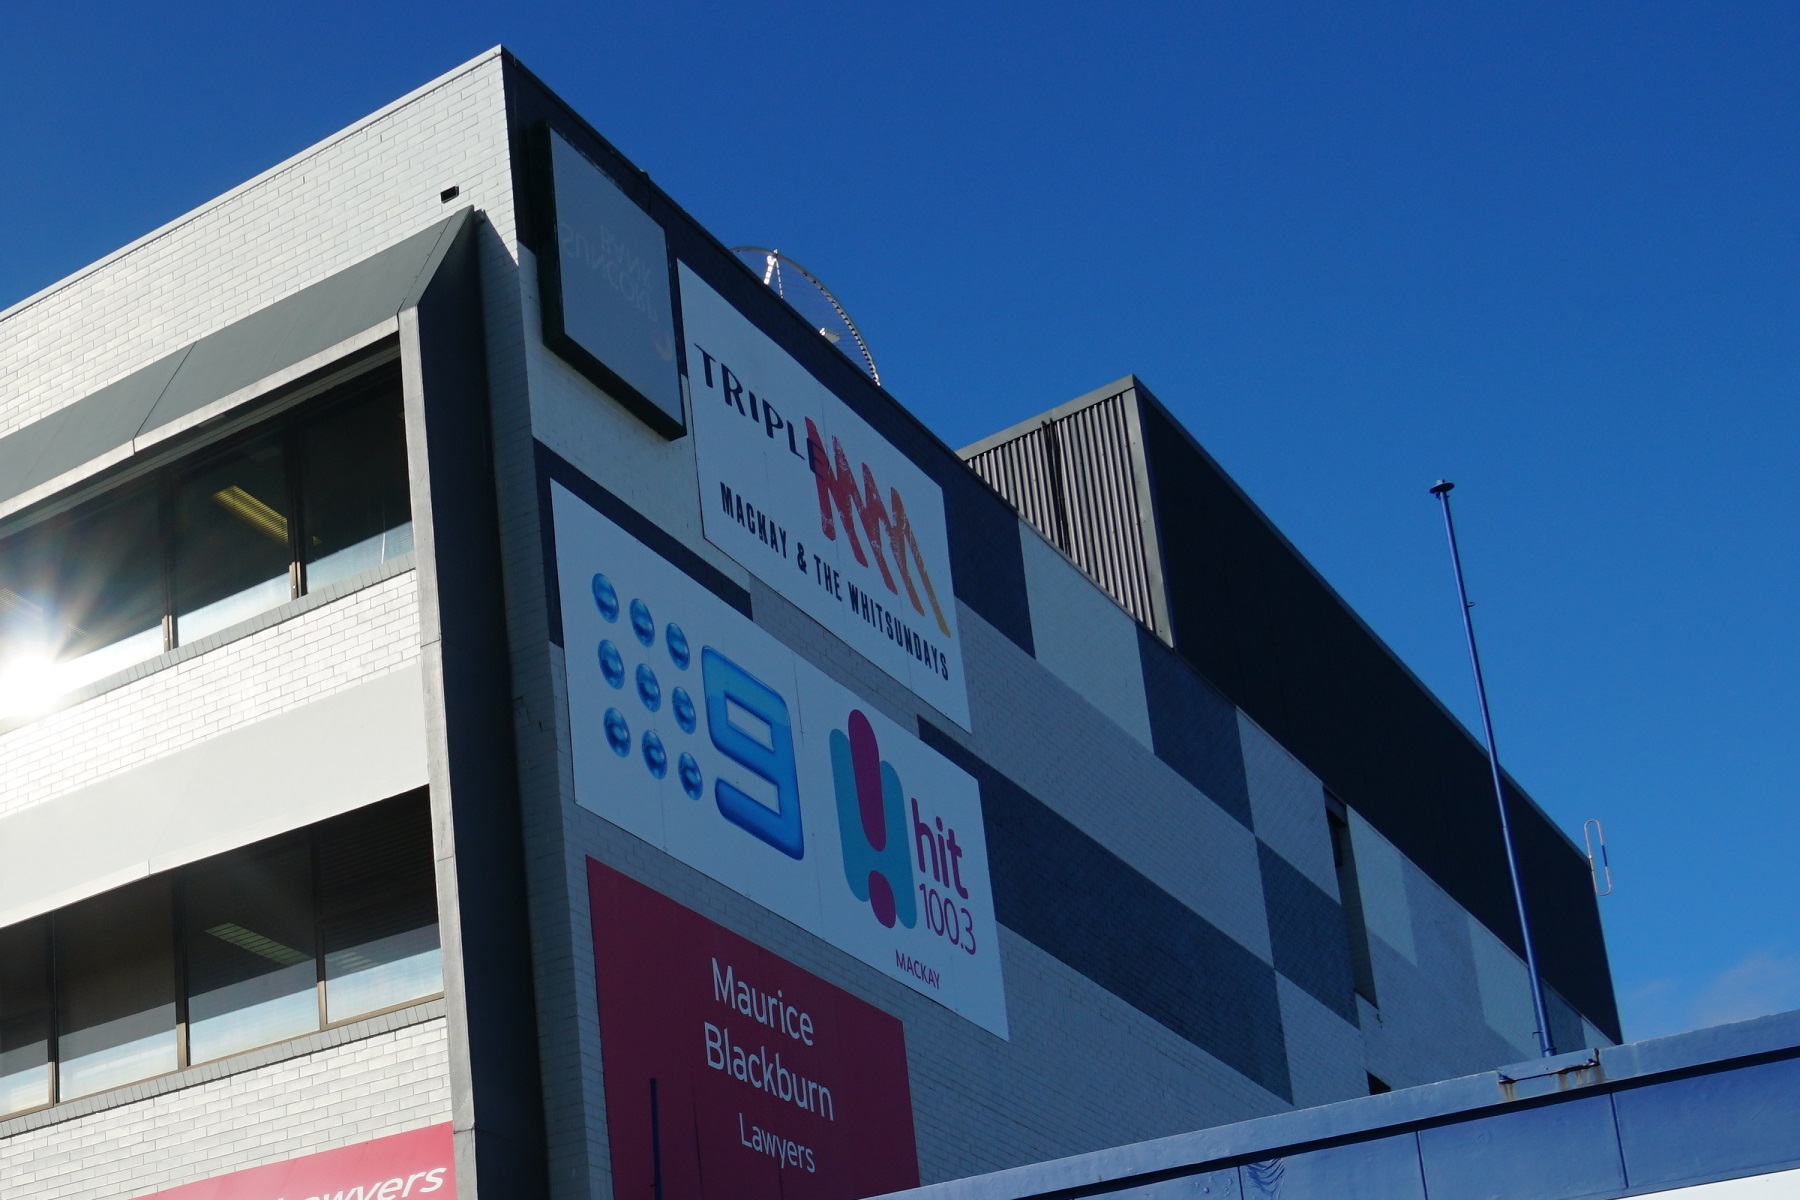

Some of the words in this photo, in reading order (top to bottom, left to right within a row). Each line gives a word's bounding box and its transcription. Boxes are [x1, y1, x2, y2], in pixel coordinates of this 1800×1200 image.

[693, 342, 831, 481] TRIPLE
[720, 481, 787, 559] MACKAY
[797, 542, 807, 575] &
[813, 554, 842, 602] THE
[848, 581, 949, 681] WHITSUNDAYS
[911, 797, 968, 900] hit
[919, 883, 976, 955] 100.3
[711, 956, 814, 1046] Maurice
[895, 948, 940, 990] MACKAY
[704, 1021, 834, 1122] Blackburn
[738, 1112, 816, 1173] Lawyers
